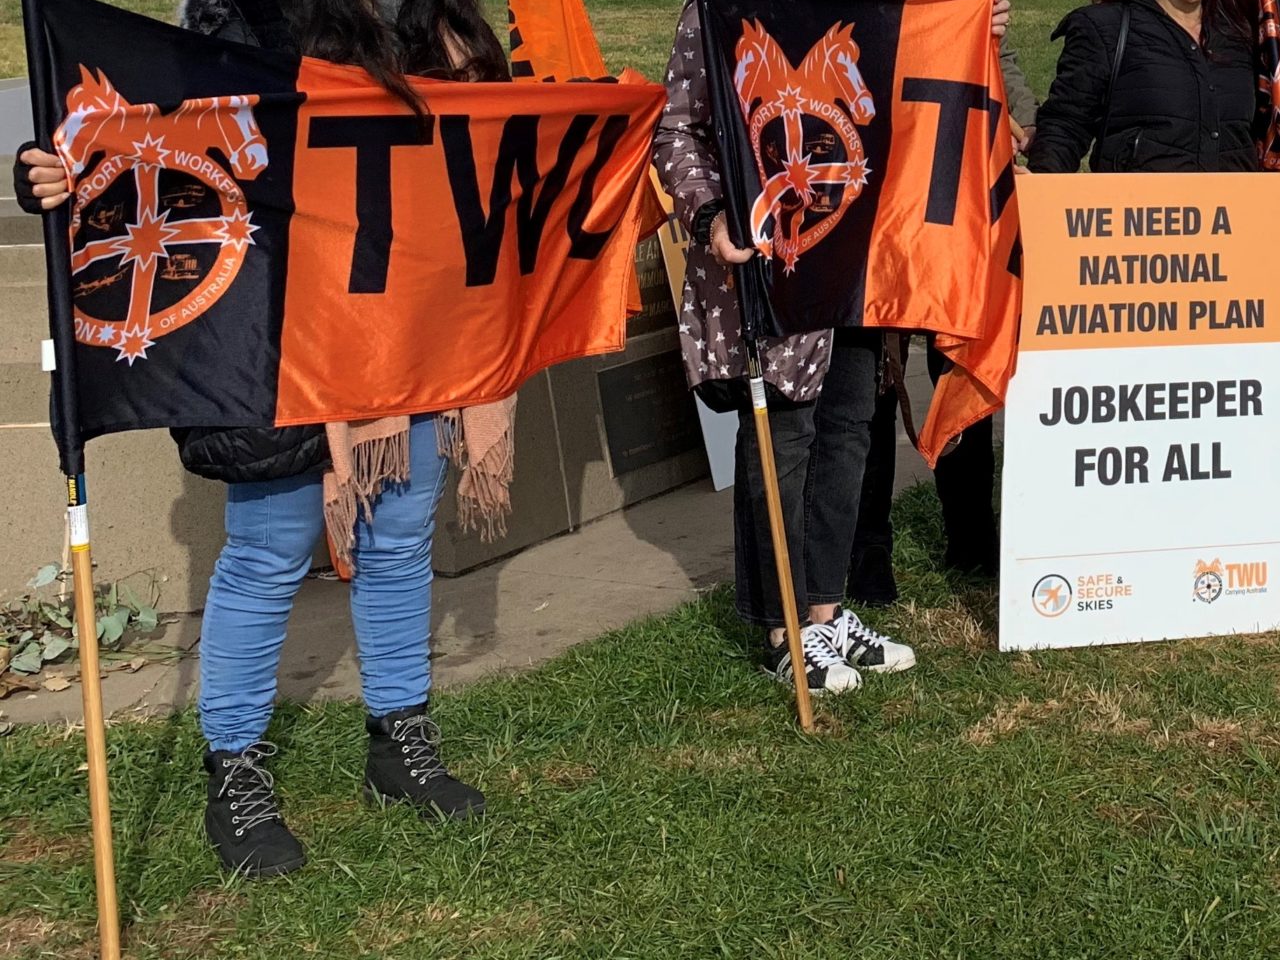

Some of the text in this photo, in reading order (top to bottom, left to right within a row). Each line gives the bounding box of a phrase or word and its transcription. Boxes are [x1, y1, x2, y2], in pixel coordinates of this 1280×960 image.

[308, 114, 631, 295] TWU
[1065, 205, 1231, 238] WE NEED A
[1079, 253, 1228, 286] NATIONAL
[160, 257, 237, 329] OF AUSTRALIA
[1036, 299, 1265, 335] AVIATION PLAN
[1039, 379, 1263, 426] JOBKEEPER
[1074, 441, 1232, 487] FOR ALL
[1077, 575, 1113, 587] SAFE
[1225, 561, 1267, 588] TWU
[1077, 584, 1133, 599] SECURE
[1077, 599, 1114, 611] SKIES
